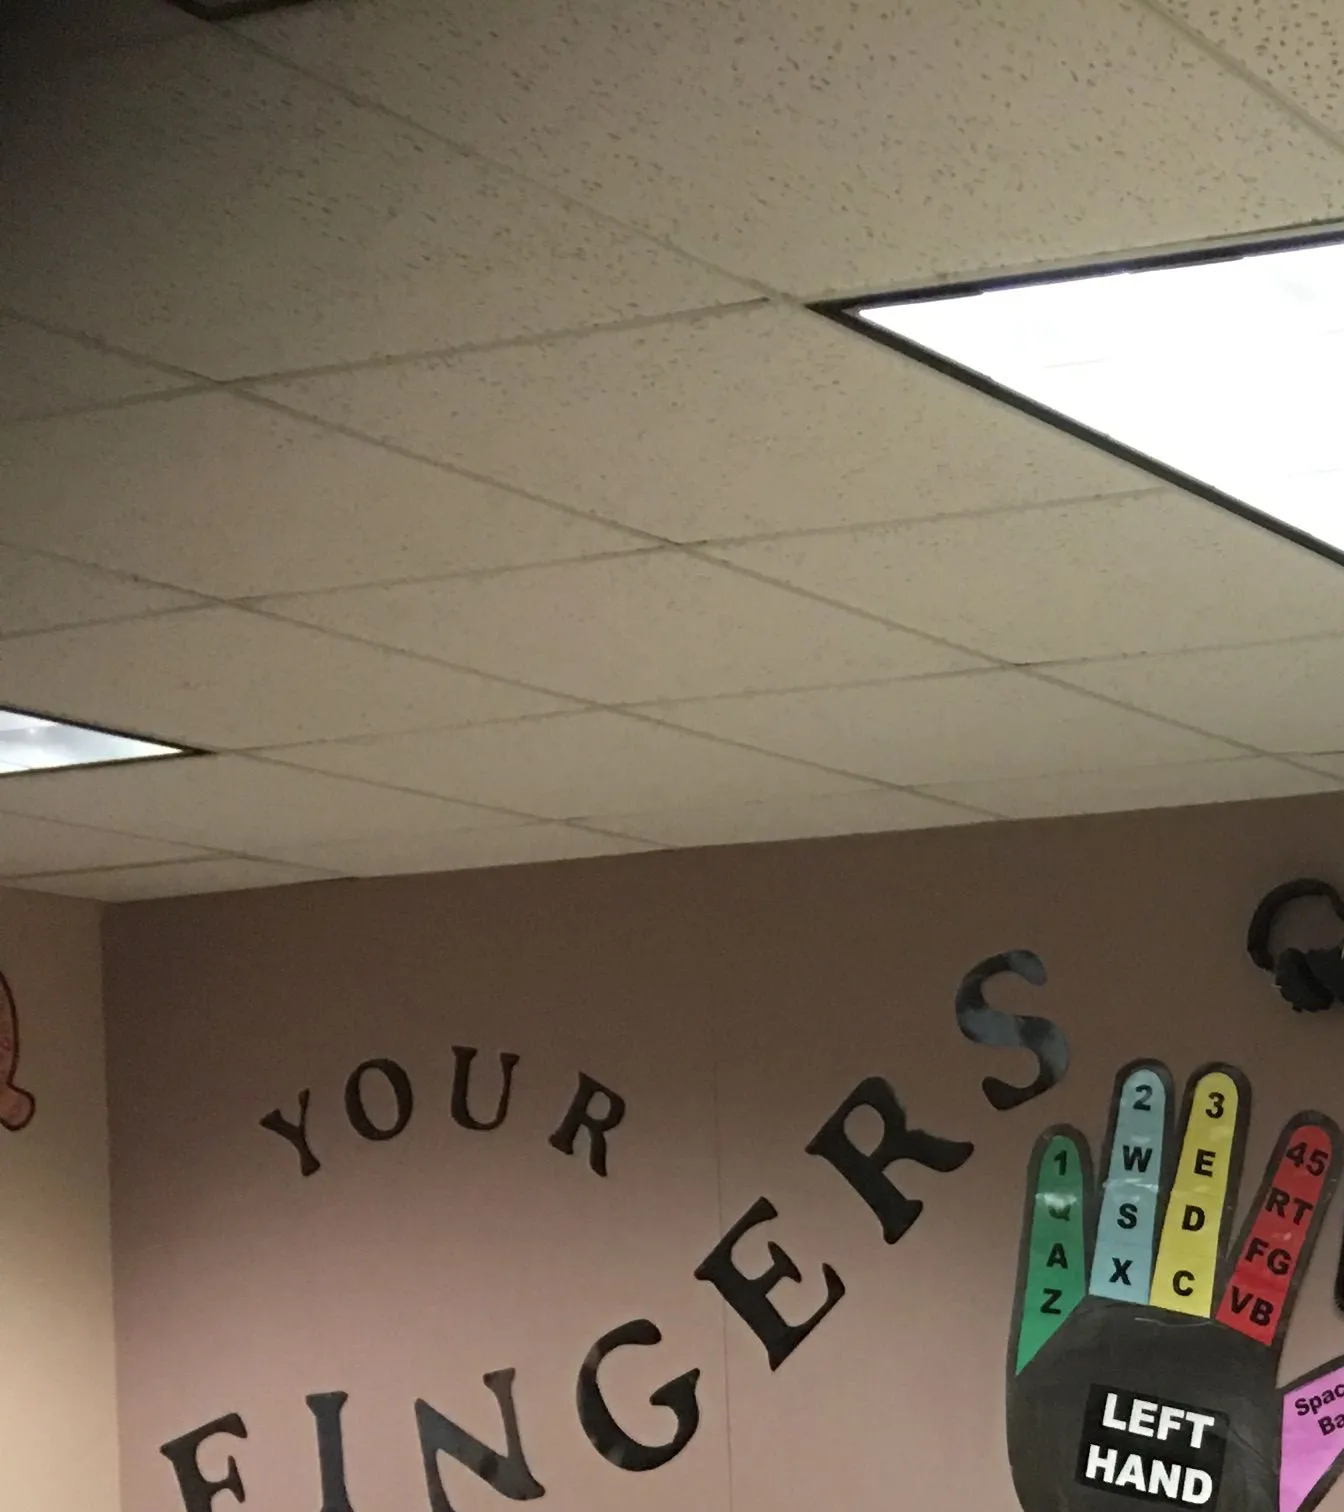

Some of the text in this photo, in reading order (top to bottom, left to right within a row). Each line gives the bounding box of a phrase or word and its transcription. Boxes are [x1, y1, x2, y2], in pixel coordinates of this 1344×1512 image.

[261, 1046, 626, 1177] YOUR
[1133, 1085, 1152, 1111] 2
[1206, 1092, 1224, 1119] 3
[1054, 1150, 1067, 1175] 1
[1123, 1145, 1152, 1172] W
[1194, 1149, 1215, 1177] E
[1285, 1141, 1329, 1178] 45
[1117, 1203, 1137, 1229] S
[1182, 1205, 1205, 1231] D
[1265, 1186, 1313, 1225] RT
[1047, 1243, 1068, 1269] A
[1245, 1238, 1291, 1275] FG
[1110, 1258, 1132, 1285] X
[1173, 1271, 1194, 1296] C
[1041, 1288, 1062, 1314] Z
[1232, 1286, 1273, 1326] VB
[1101, 1392, 1216, 1450] LEFT
[1084, 1443, 1215, 1505] HAND
